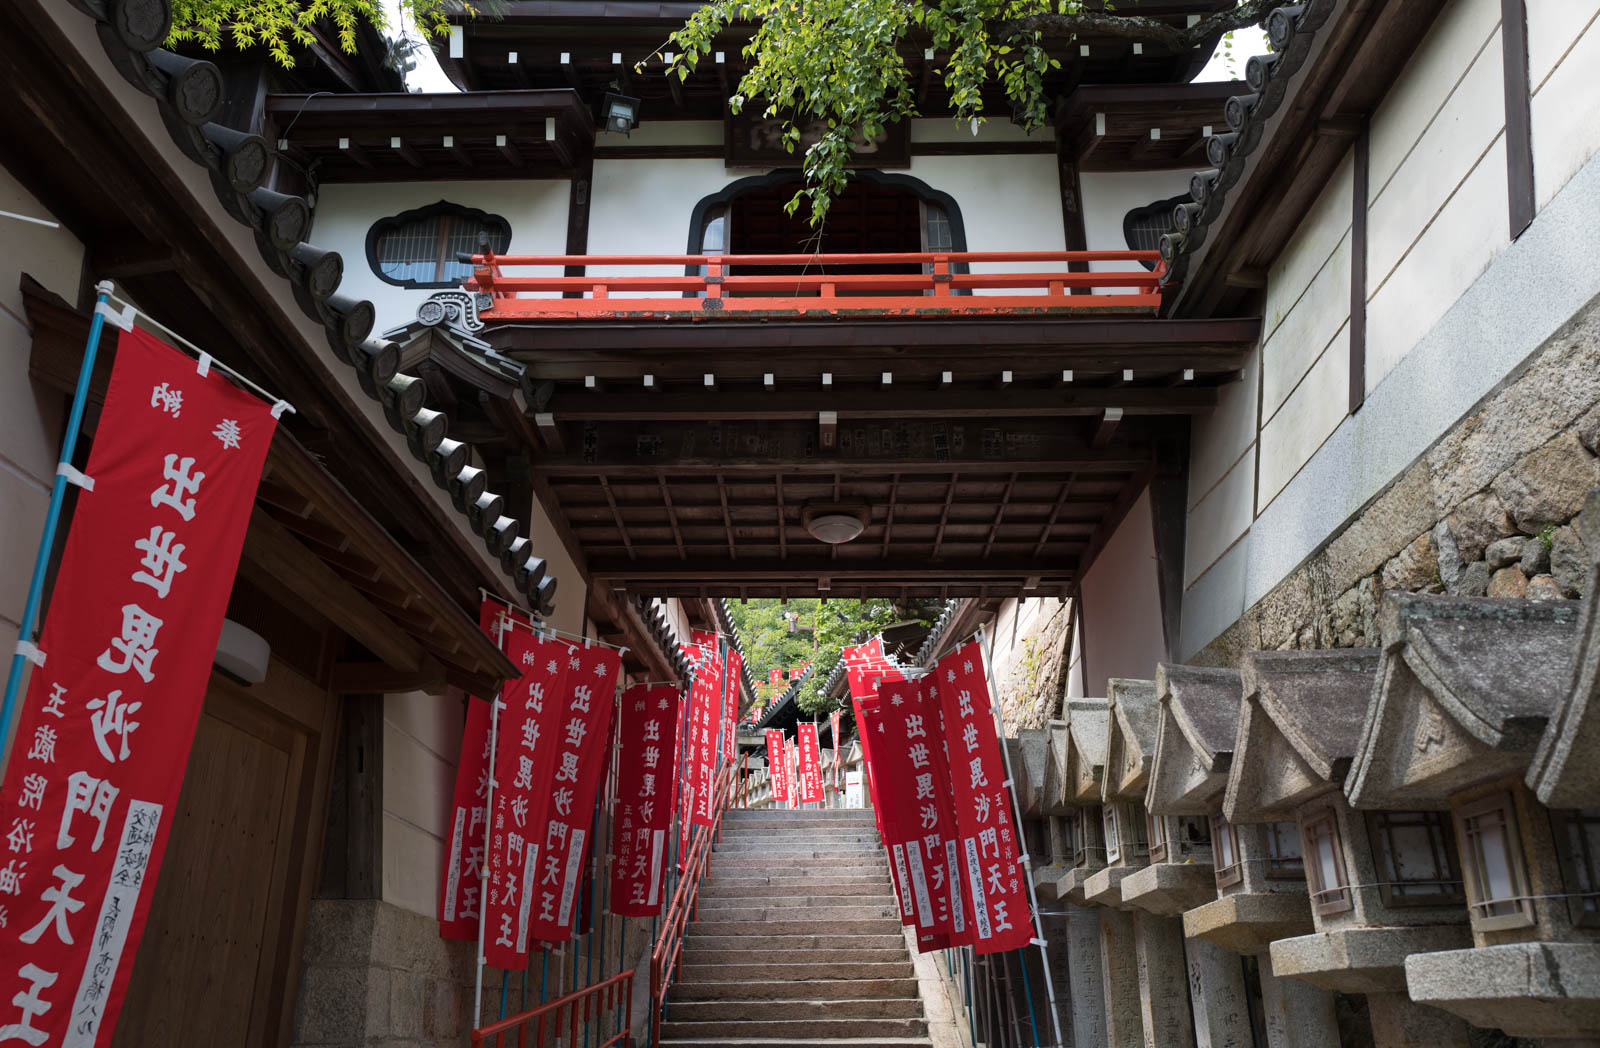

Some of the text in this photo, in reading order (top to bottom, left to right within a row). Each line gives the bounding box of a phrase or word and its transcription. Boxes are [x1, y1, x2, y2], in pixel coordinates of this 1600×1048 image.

[958, 690, 1013, 933] 出世毘沙門天王
